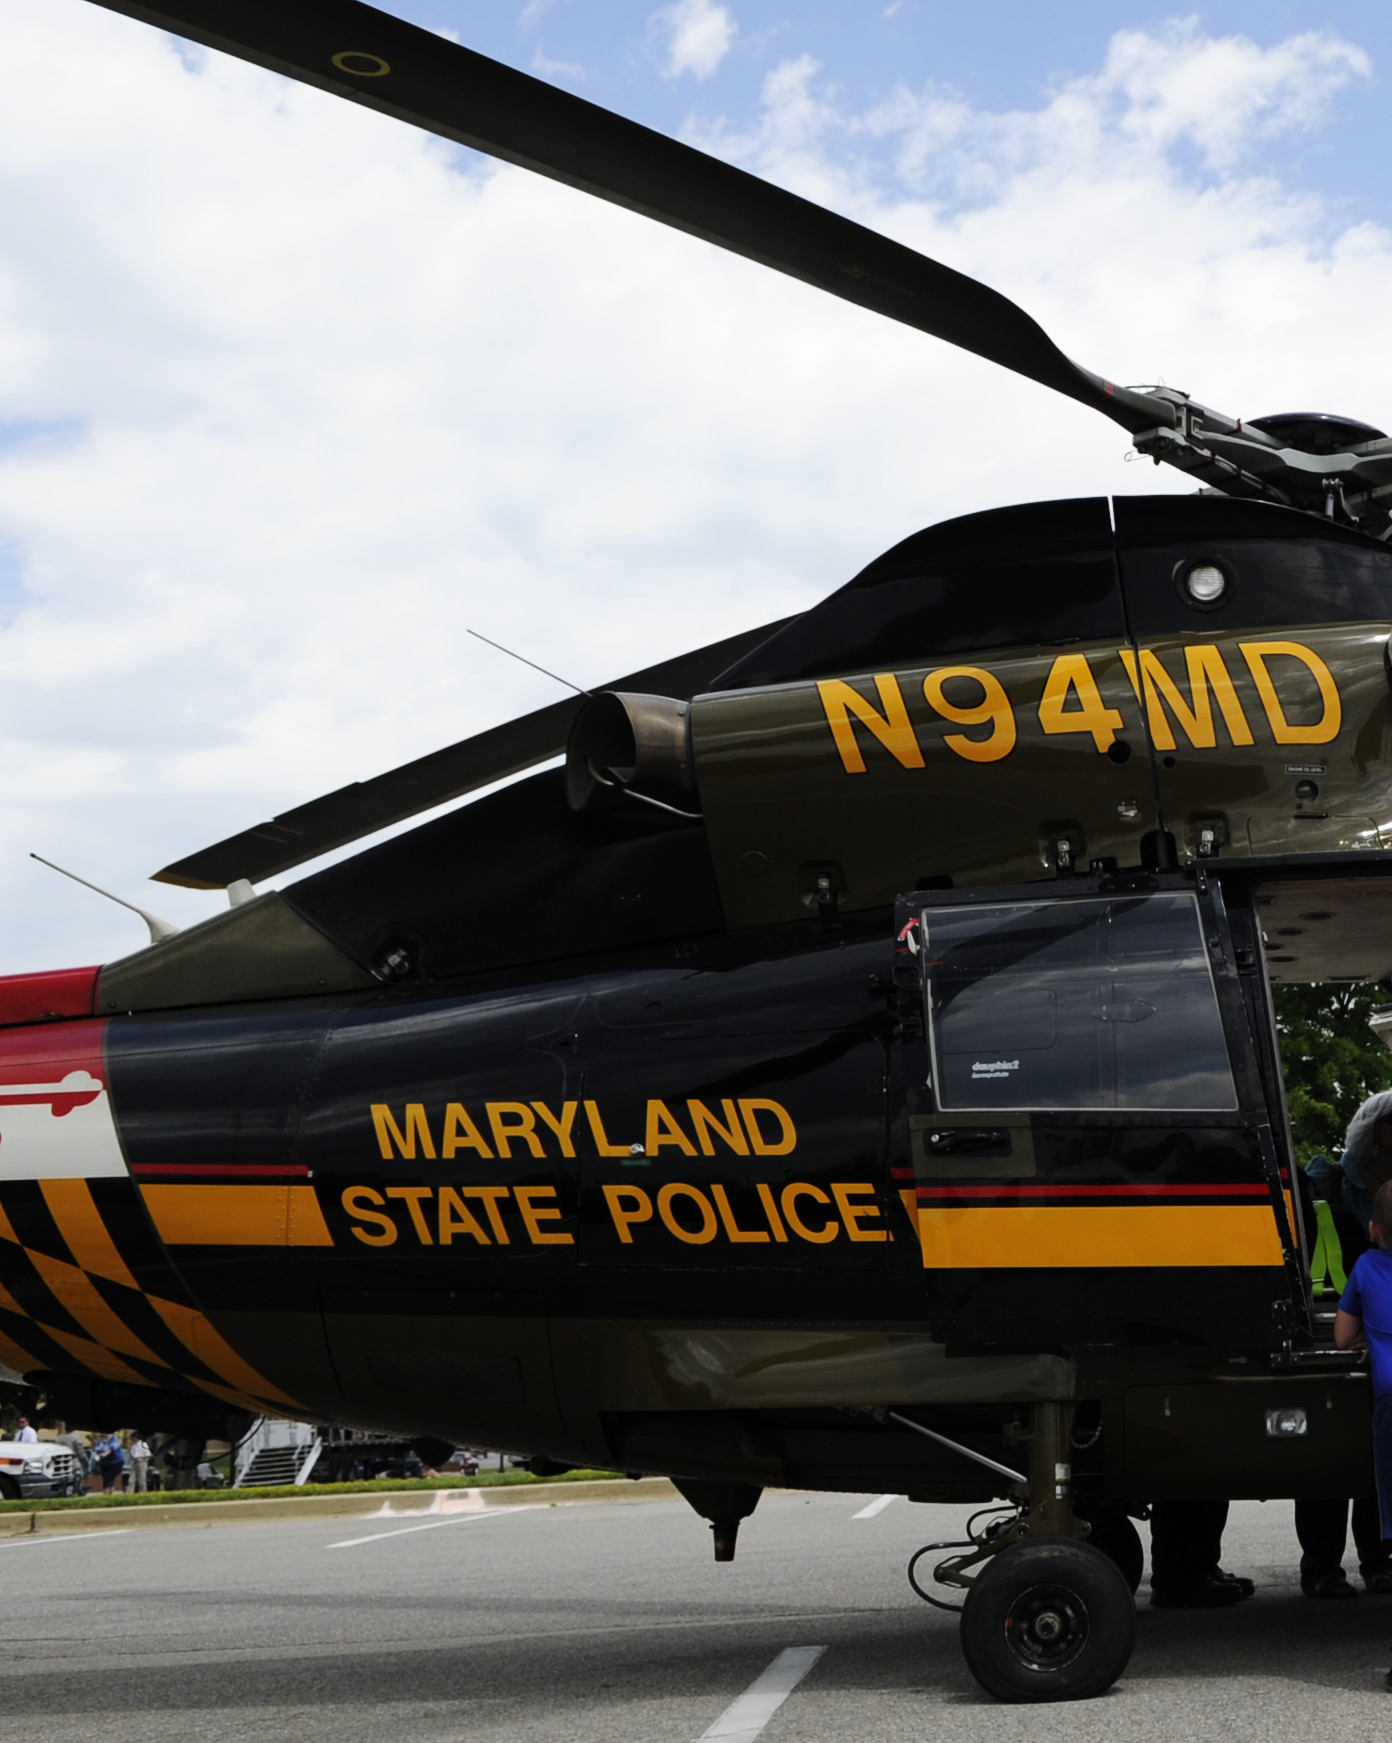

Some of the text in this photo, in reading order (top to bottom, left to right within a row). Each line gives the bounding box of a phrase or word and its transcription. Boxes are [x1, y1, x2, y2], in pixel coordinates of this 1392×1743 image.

[816, 640, 1342, 774] N94MD
[370, 1098, 797, 1160] MARYLAND
[340, 1182, 895, 1247] STATE POLICE
